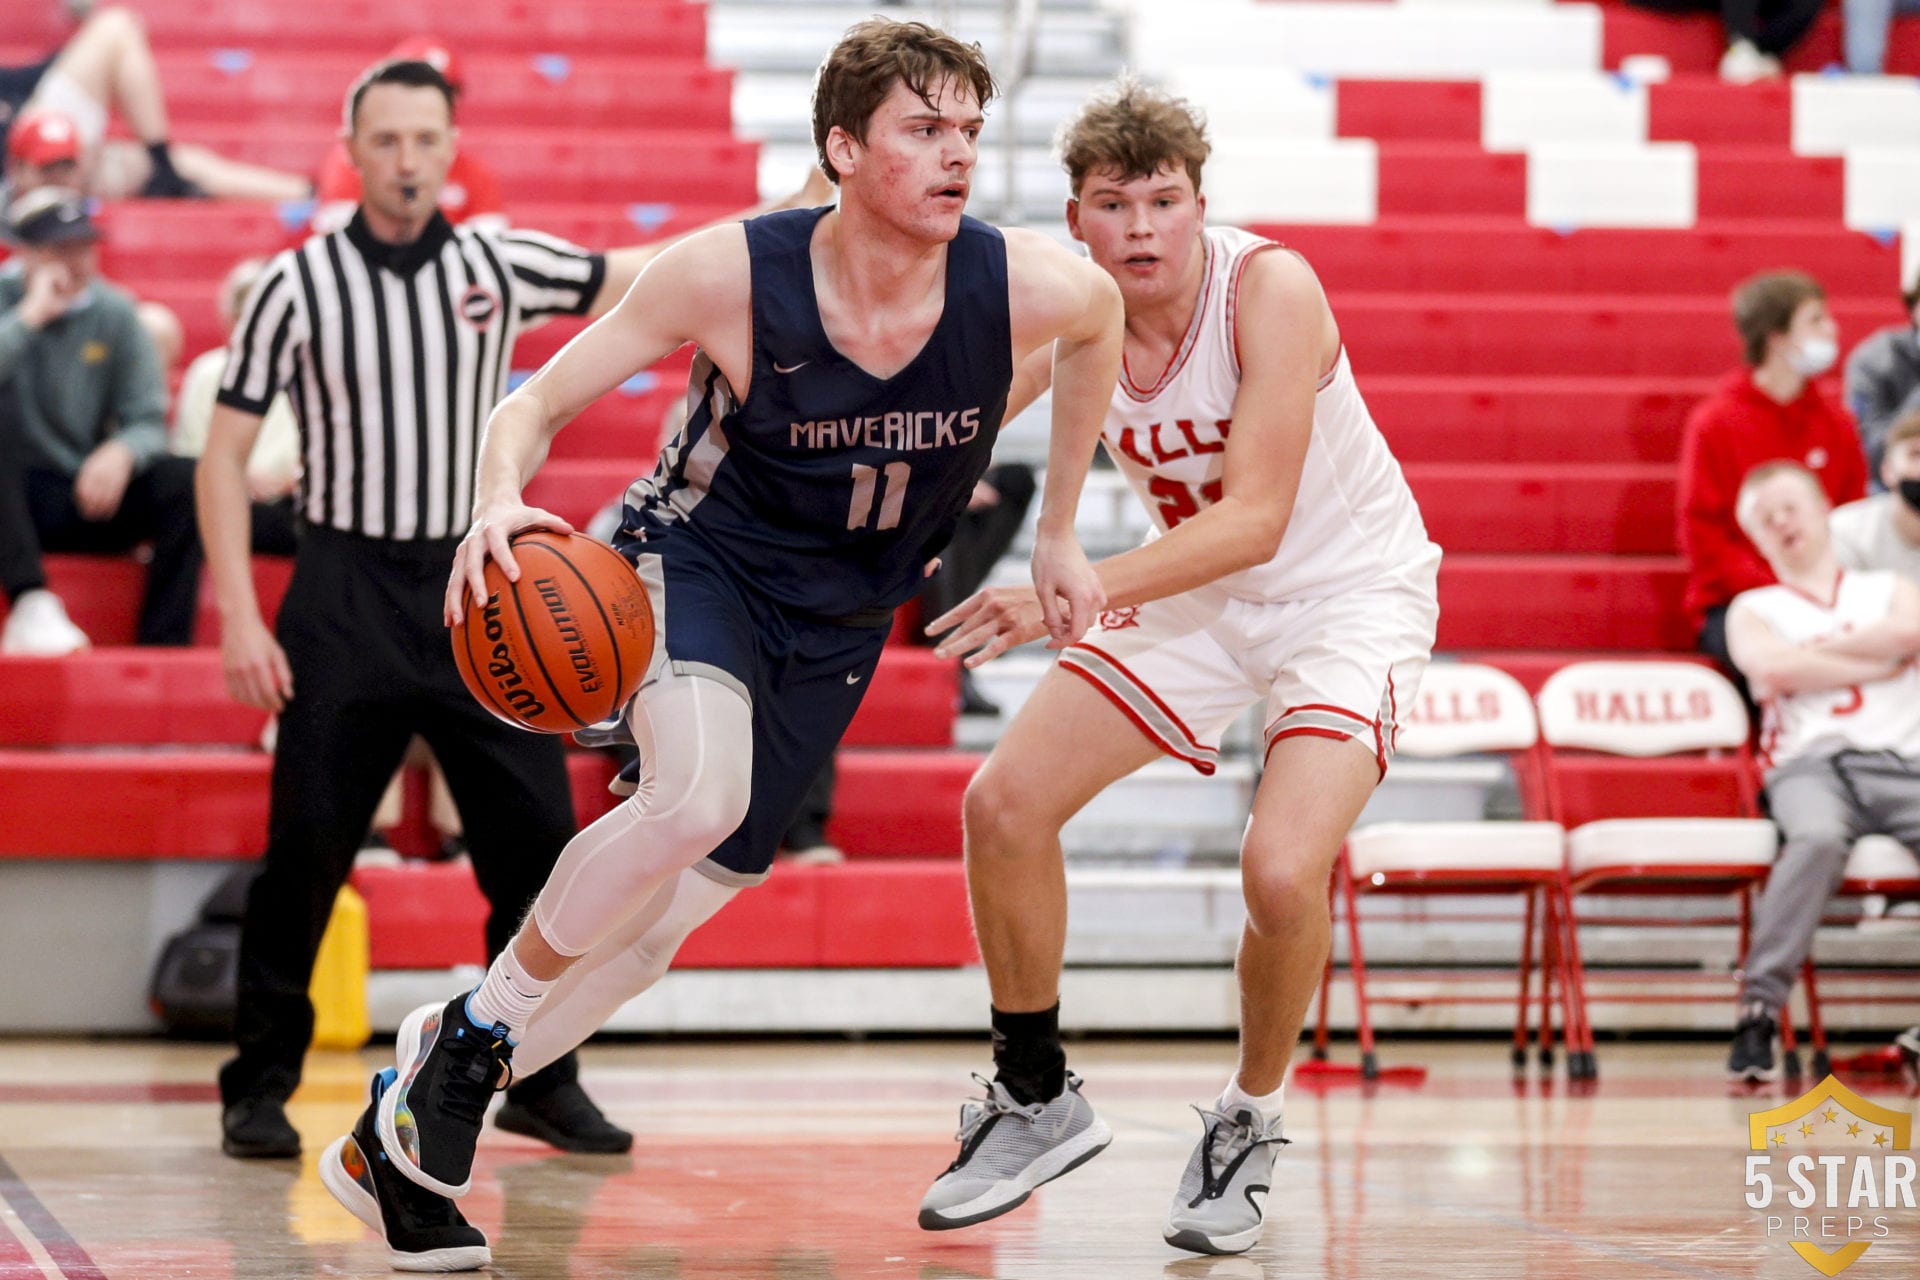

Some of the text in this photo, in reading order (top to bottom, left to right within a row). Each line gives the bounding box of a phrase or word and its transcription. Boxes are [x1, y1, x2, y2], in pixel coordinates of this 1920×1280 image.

[790, 407, 980, 451] MAVERICKS
[1101, 419, 1232, 467] ALL
[846, 461, 912, 531] 11
[1148, 474, 1223, 529] 2
[484, 590, 545, 720] Wilson
[533, 578, 599, 694] EVOLUTION
[1574, 689, 1713, 723] HALLS
